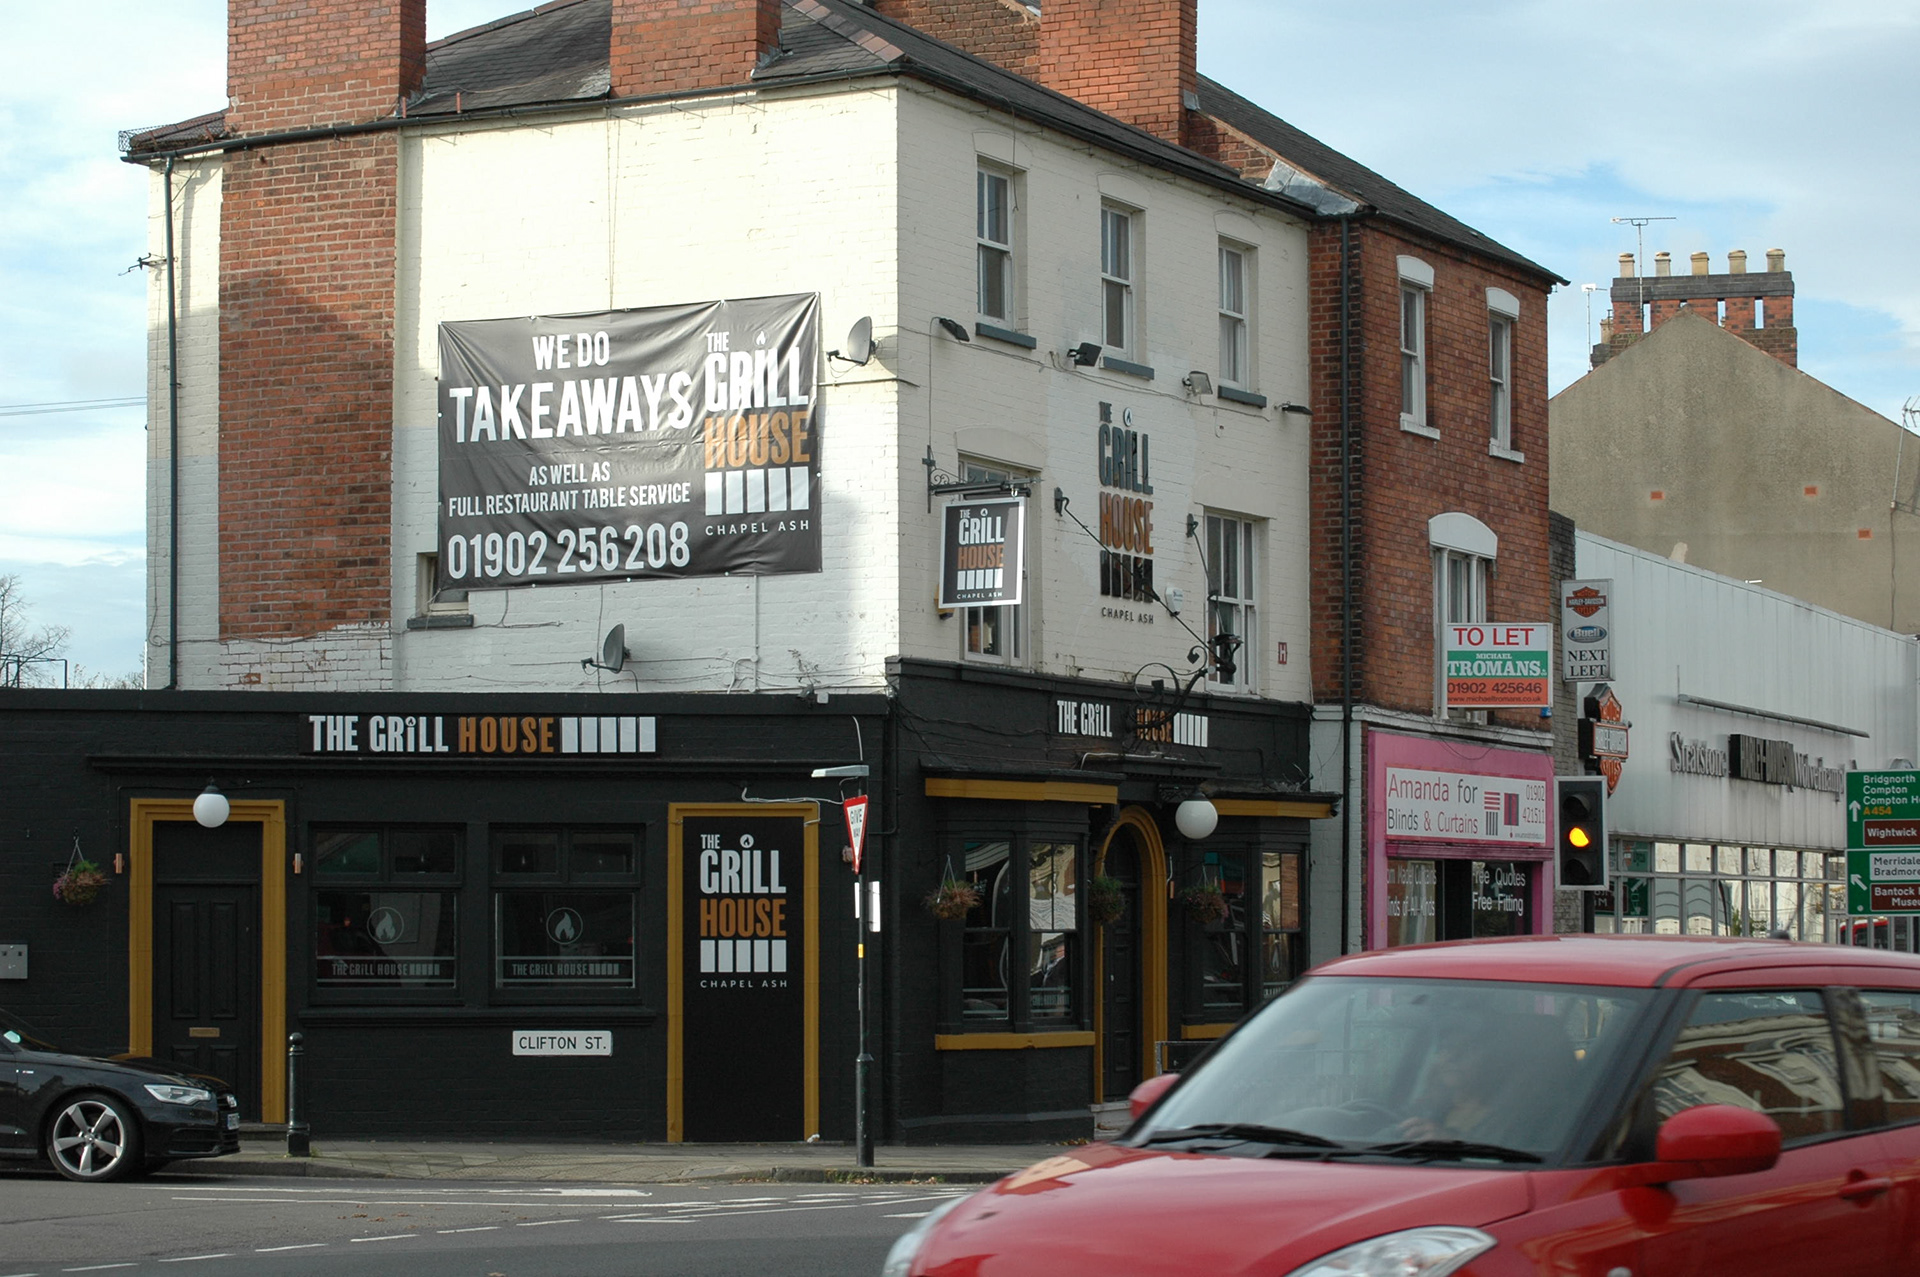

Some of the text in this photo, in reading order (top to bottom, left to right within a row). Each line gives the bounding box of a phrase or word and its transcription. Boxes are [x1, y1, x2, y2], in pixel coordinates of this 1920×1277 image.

[706, 331, 729, 353] THE
[532, 331, 610, 371] WE DO
[705, 342, 809, 412] GRILL
[1099, 401, 1112, 424] THE
[705, 411, 810, 469] HOUSE
[529, 461, 610, 486] AS WELL AS
[449, 482, 690, 517] FULL RESTAURANT TABLE SERVICE
[960, 509, 970, 519] THE
[705, 519, 810, 536] CHAPEL ASH
[1100, 491, 1154, 555] HOUSE
[448, 521, 690, 579] 01902 256 208
[958, 544, 1005, 569] HOUSE
[1101, 606, 1154, 625] CHAPEL ASH
[1453, 627, 1534, 646] TO LET
[1568, 650, 1607, 661] NEXT
[1447, 660, 1541, 676] TROMANS
[1570, 665, 1606, 677] LEFT
[1447, 682, 1542, 694] 01902 425646
[1057, 700, 1078, 734] THE
[309, 715, 555, 753] THE GRILL HOUSE
[1863, 774, 1916, 785] Bridgnorth
[1388, 773, 1478, 804] Amanda for
[1526, 784, 1545, 801] 01902
[1863, 785, 1908, 795] Compton
[1863, 796, 1908, 806] Compton
[850, 808, 862, 825] GIVE
[1863, 806, 1892, 816] A454
[1388, 808, 1478, 835] Blinds & Curtains
[701, 834, 720, 849] THE
[1867, 828, 1918, 839] Wightwick
[1874, 857, 1920, 866] Merridale
[700, 849, 786, 894] GRILL
[1495, 867, 1526, 886] Quotes
[1874, 868, 1920, 876] Bradmore
[1874, 887, 1915, 896] Bantock
[1472, 892, 1524, 916] Free Fitting
[700, 898, 786, 937] HOUSE
[332, 963, 349, 976] THE
[377, 963, 407, 976] HOUSE
[512, 963, 528, 976] THE
[557, 963, 587, 976] HOUSE
[700, 979, 787, 988] CHAPEL ASH
[519, 1036, 607, 1050] CLIFTON ST.
